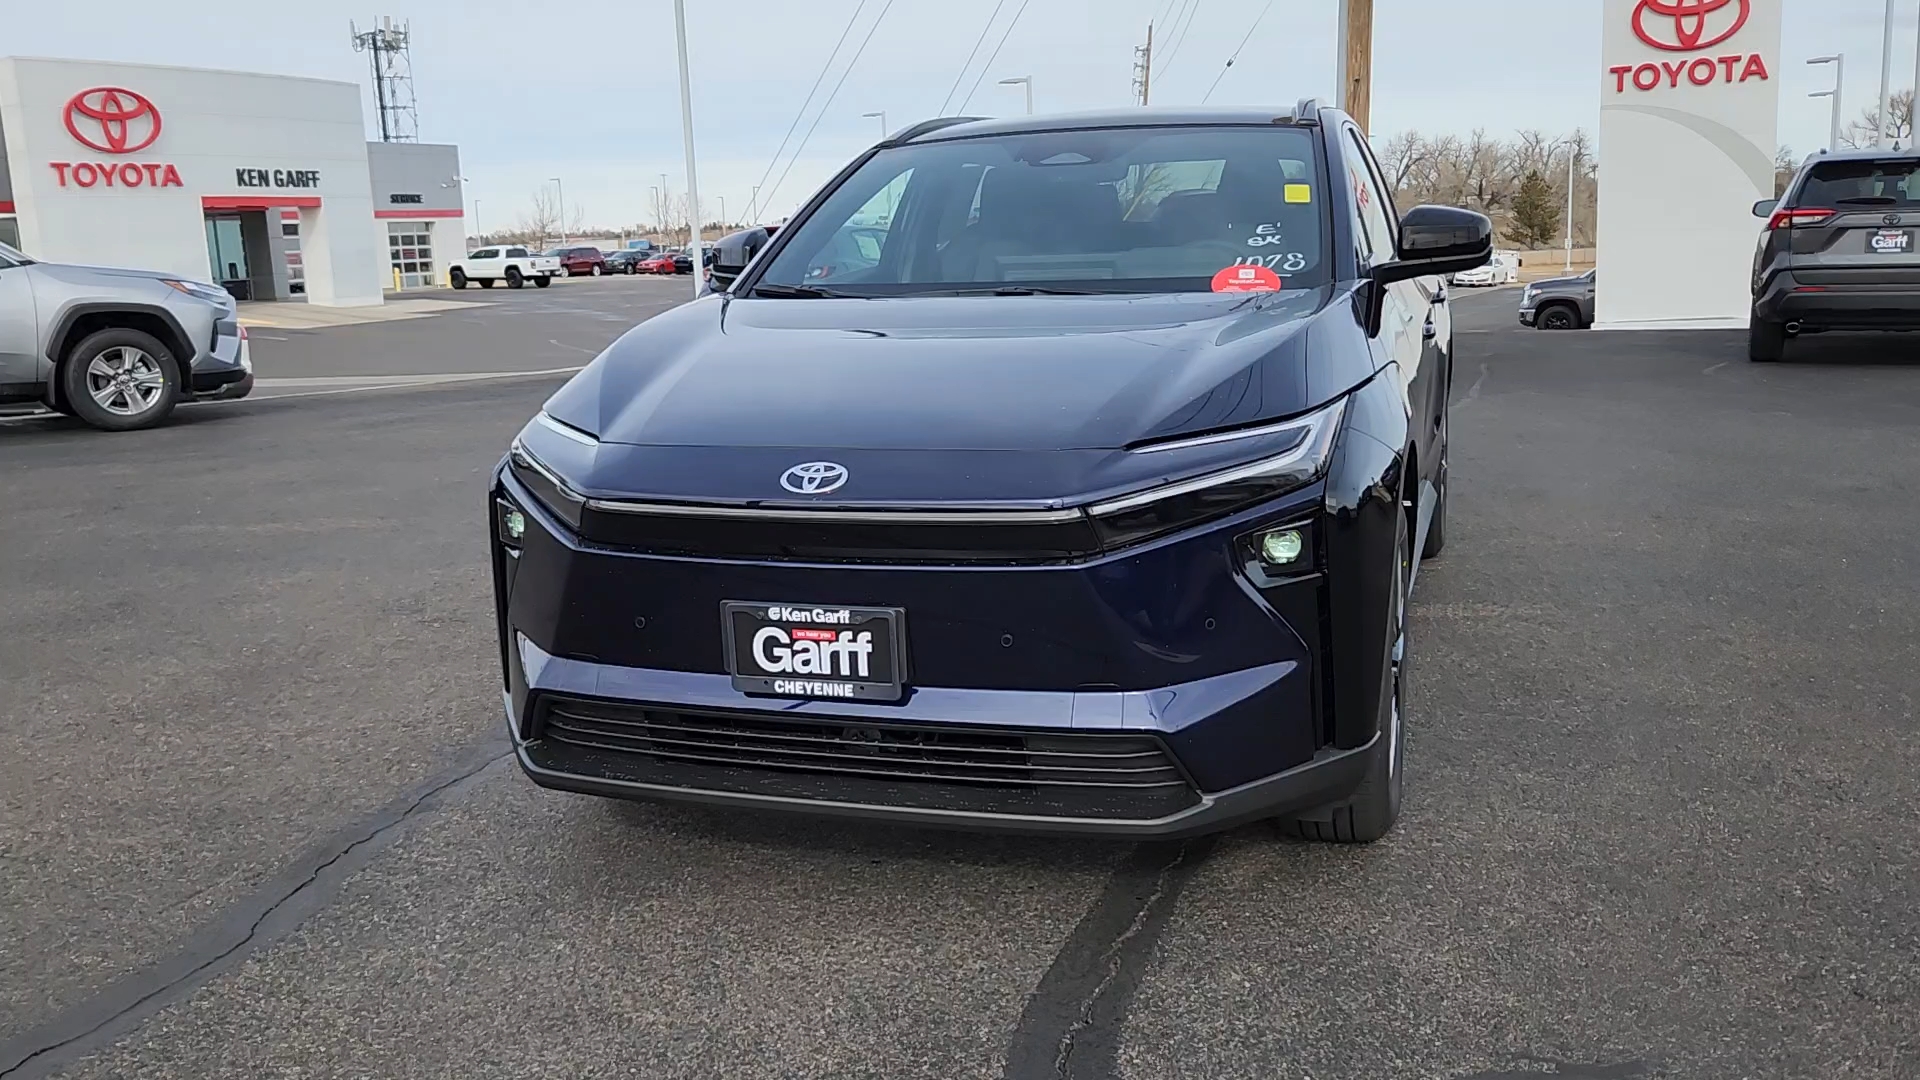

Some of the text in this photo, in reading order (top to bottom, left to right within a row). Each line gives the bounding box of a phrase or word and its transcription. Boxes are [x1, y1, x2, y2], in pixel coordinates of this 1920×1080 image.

[1609, 53, 1769, 93] TOYOTA
[49, 162, 184, 188] TOYOTA
[236, 168, 320, 188] KEN GARFF
[1871, 235, 1909, 248] Garff
[781, 607, 850, 624] Ken Garff
[752, 626, 873, 677] Garff
[774, 680, 854, 697] CHEYENNE
